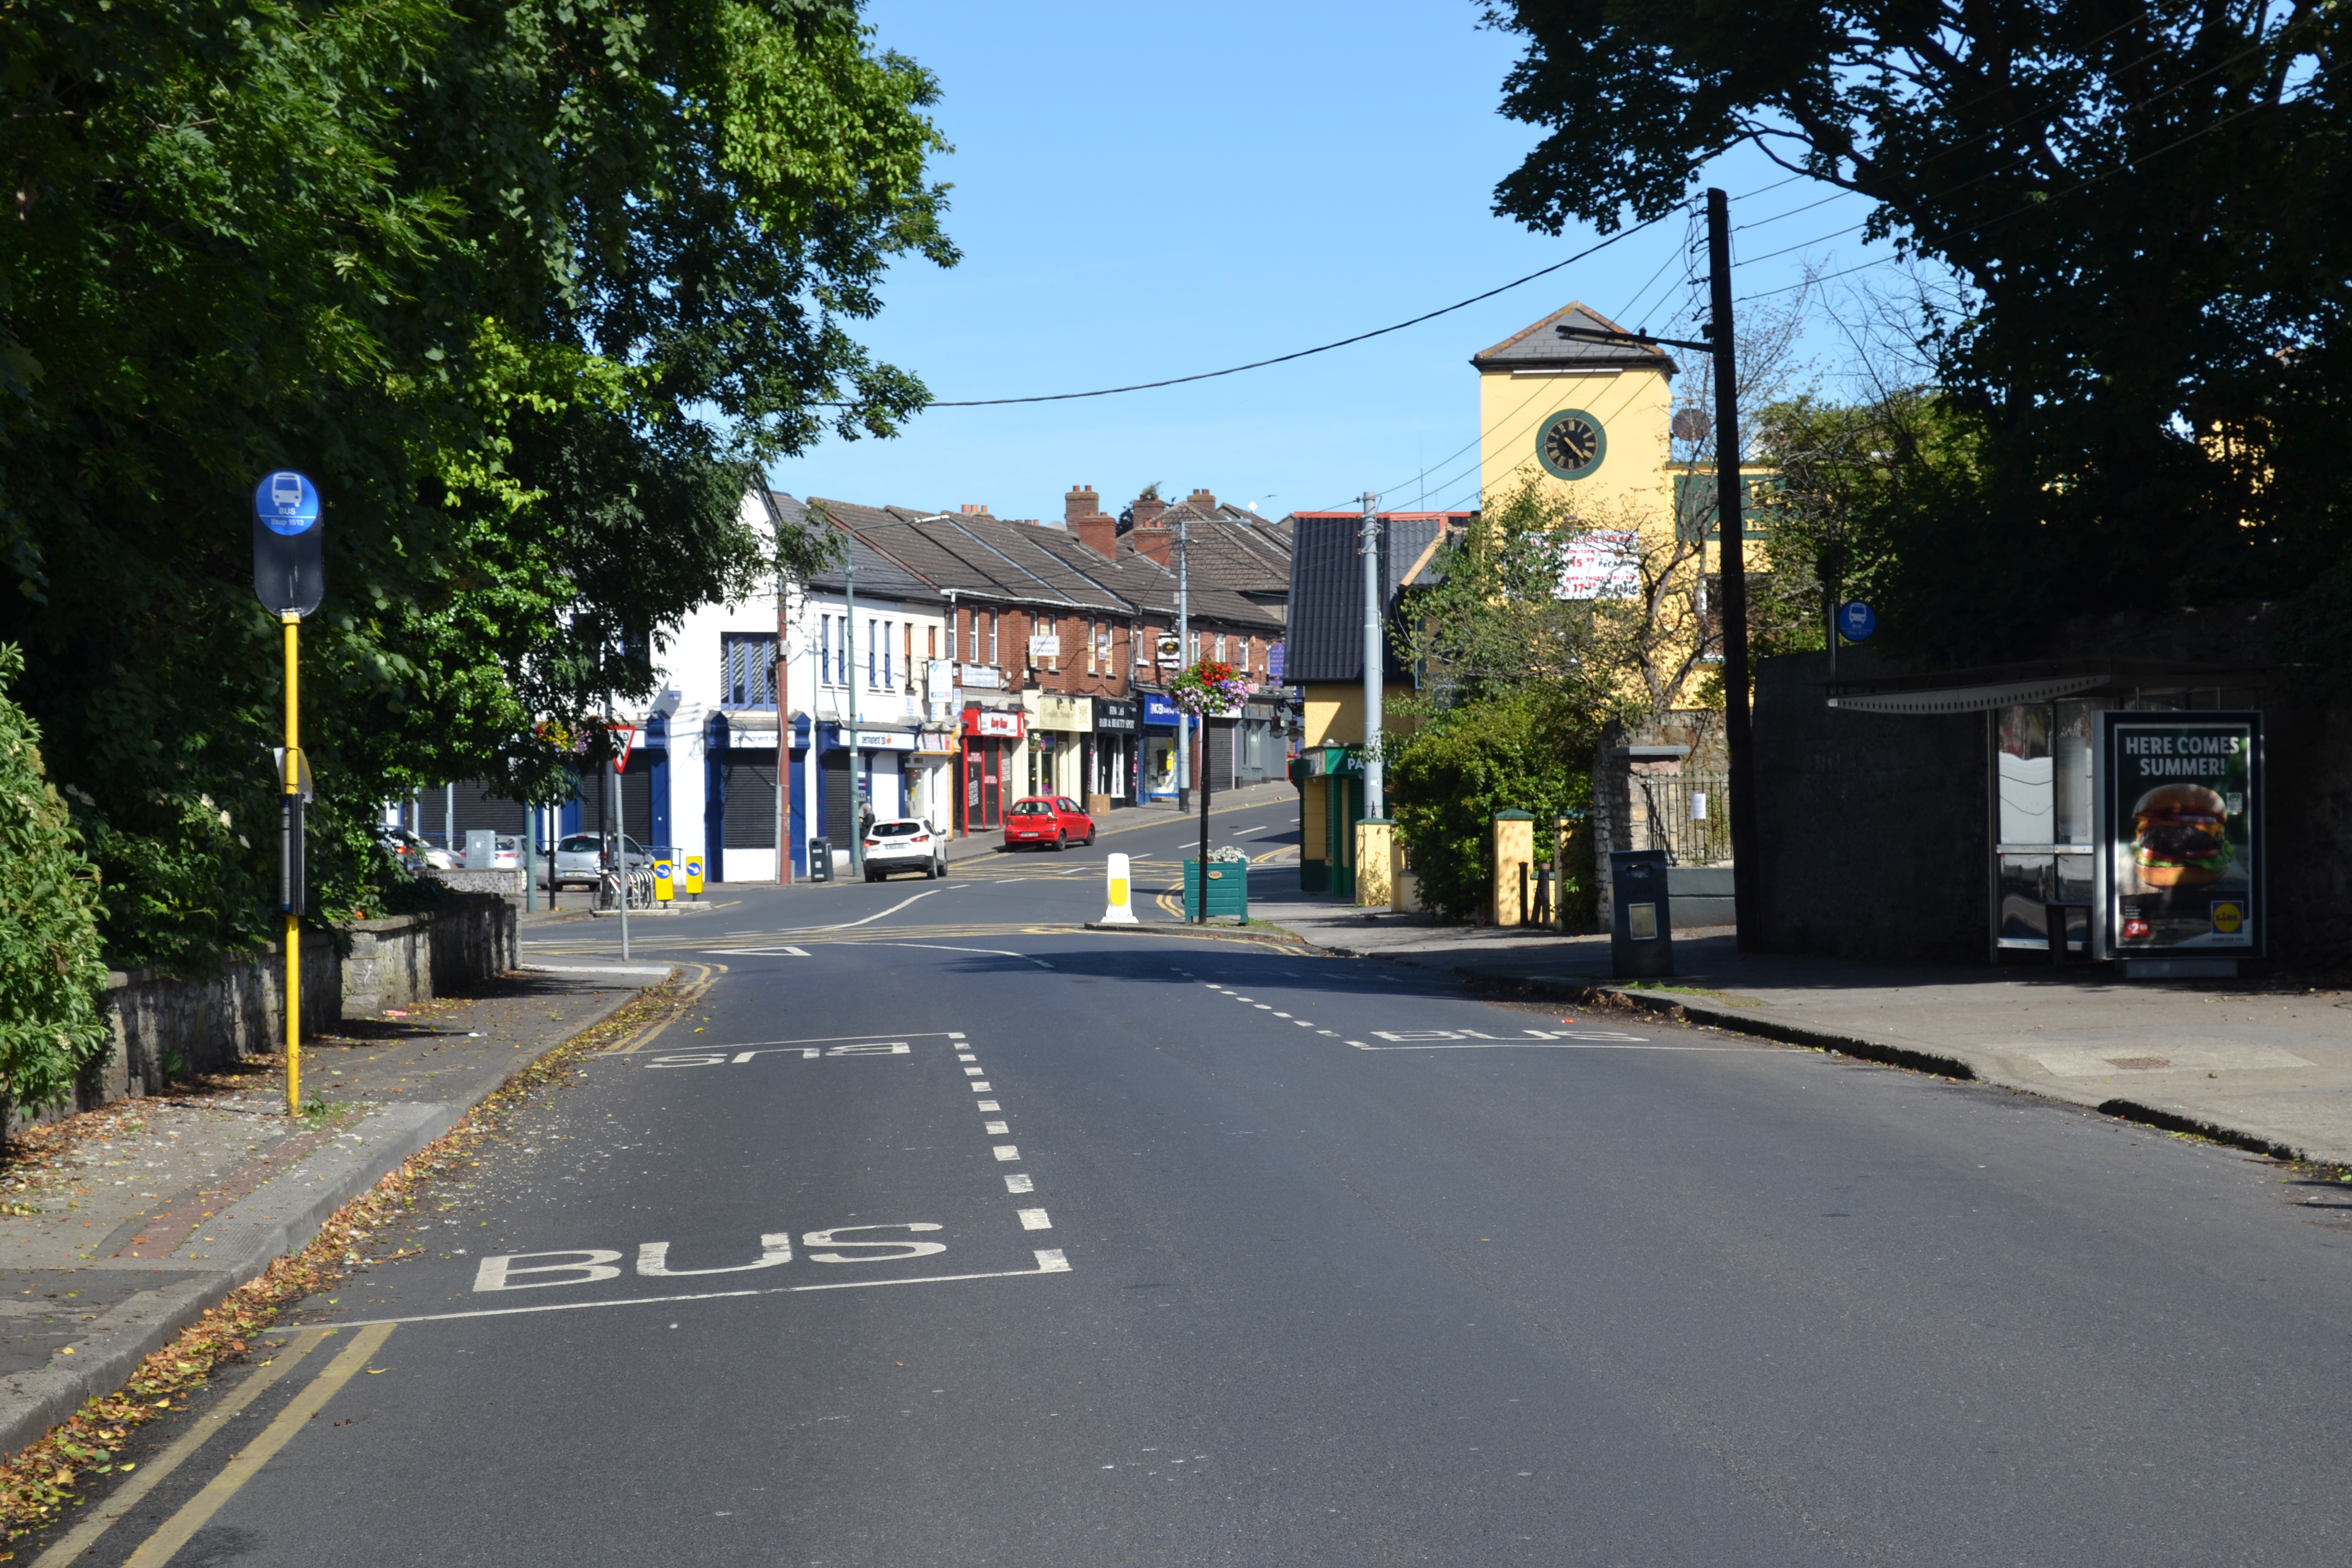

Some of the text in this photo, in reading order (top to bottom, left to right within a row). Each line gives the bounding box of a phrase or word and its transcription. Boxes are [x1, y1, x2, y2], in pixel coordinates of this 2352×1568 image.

[271, 518, 287, 526] Stop
[862, 736, 880, 746] permanent
[2126, 737, 2240, 754] HERE COMES
[2140, 758, 2225, 776] SUMMER!
[1370, 1029, 1650, 1042] BUS
[644, 1042, 911, 1069] BUS
[472, 1222, 947, 1292] BUS
